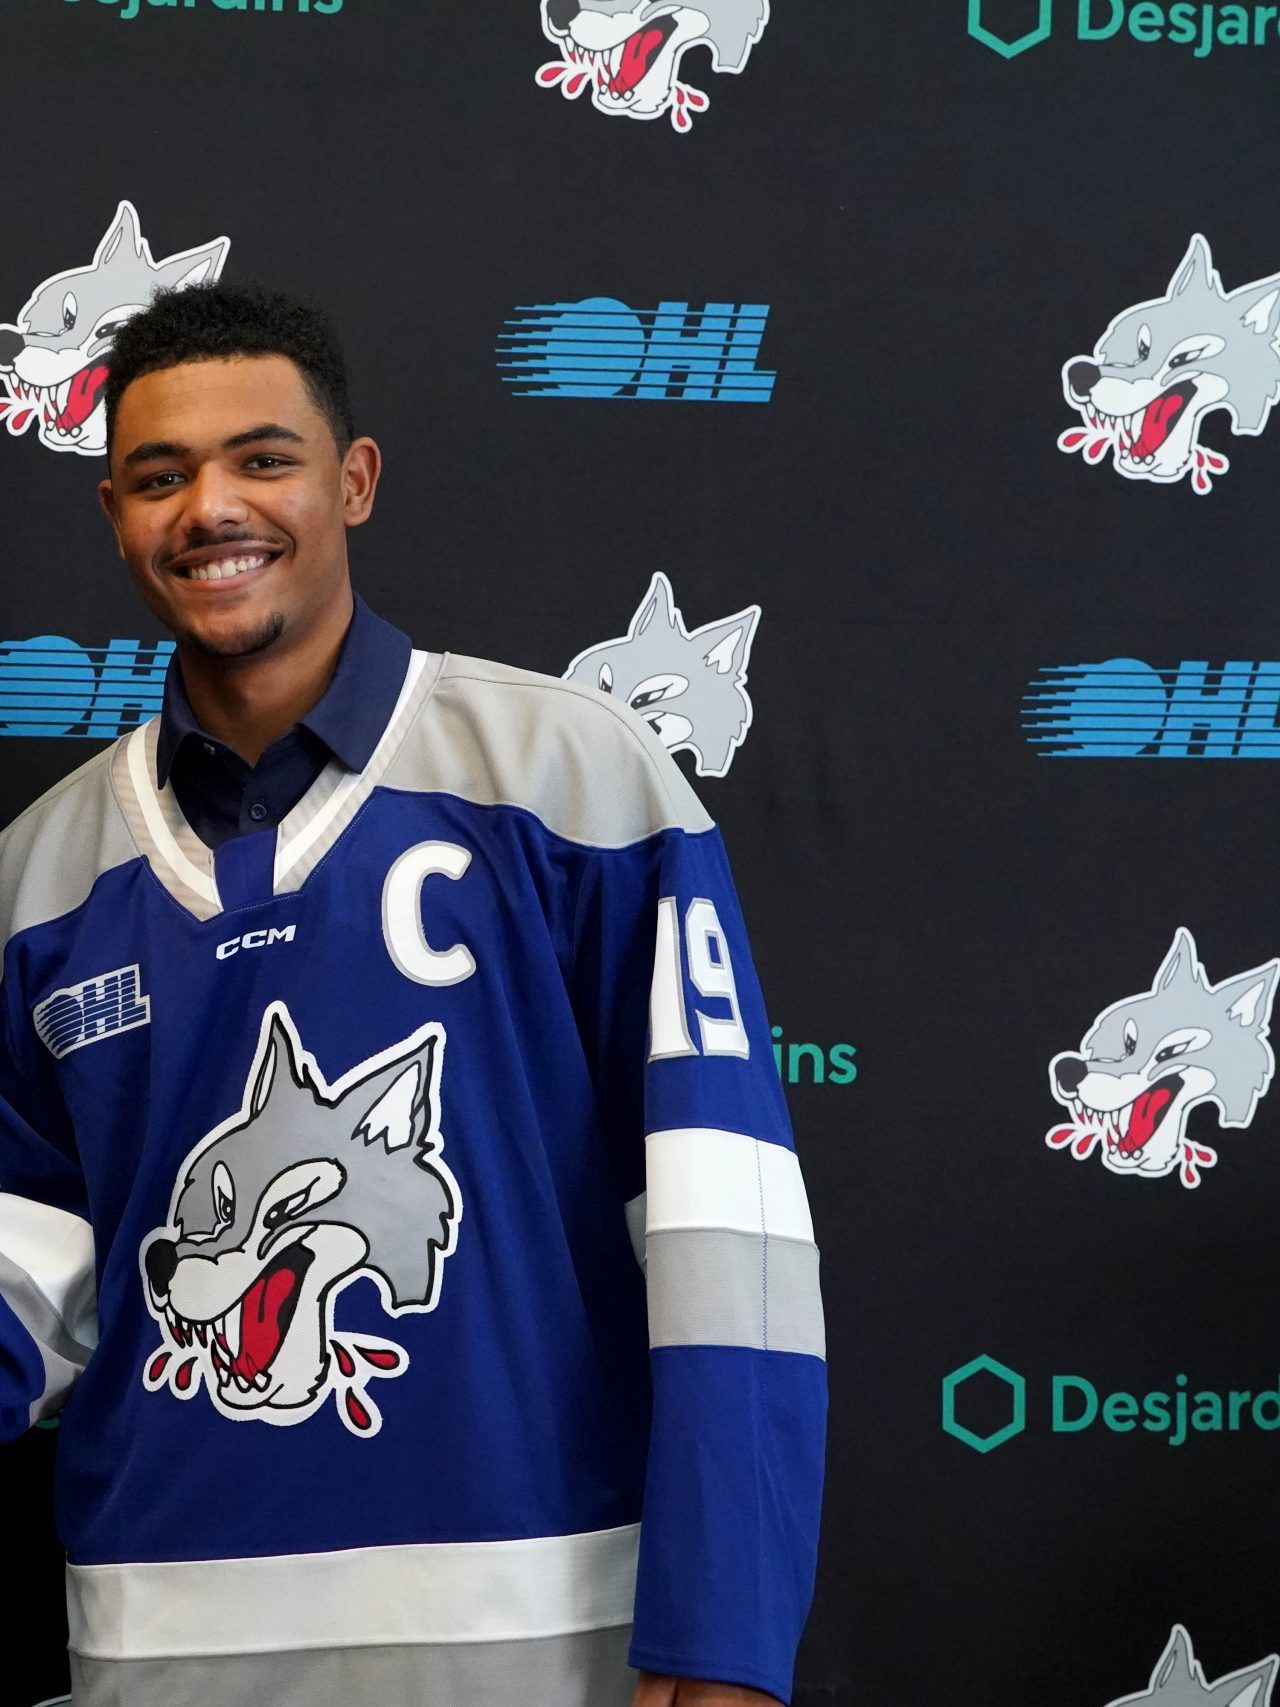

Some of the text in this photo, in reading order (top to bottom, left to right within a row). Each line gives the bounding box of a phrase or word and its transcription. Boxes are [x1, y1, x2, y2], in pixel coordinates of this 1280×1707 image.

[1077, 0, 1280, 57] Desjar
[495, 296, 777, 402] OHL
[216, 925, 296, 960] CCM
[382, 840, 476, 986] C
[33, 965, 149, 1057] OHL
[647, 896, 750, 1064] 19
